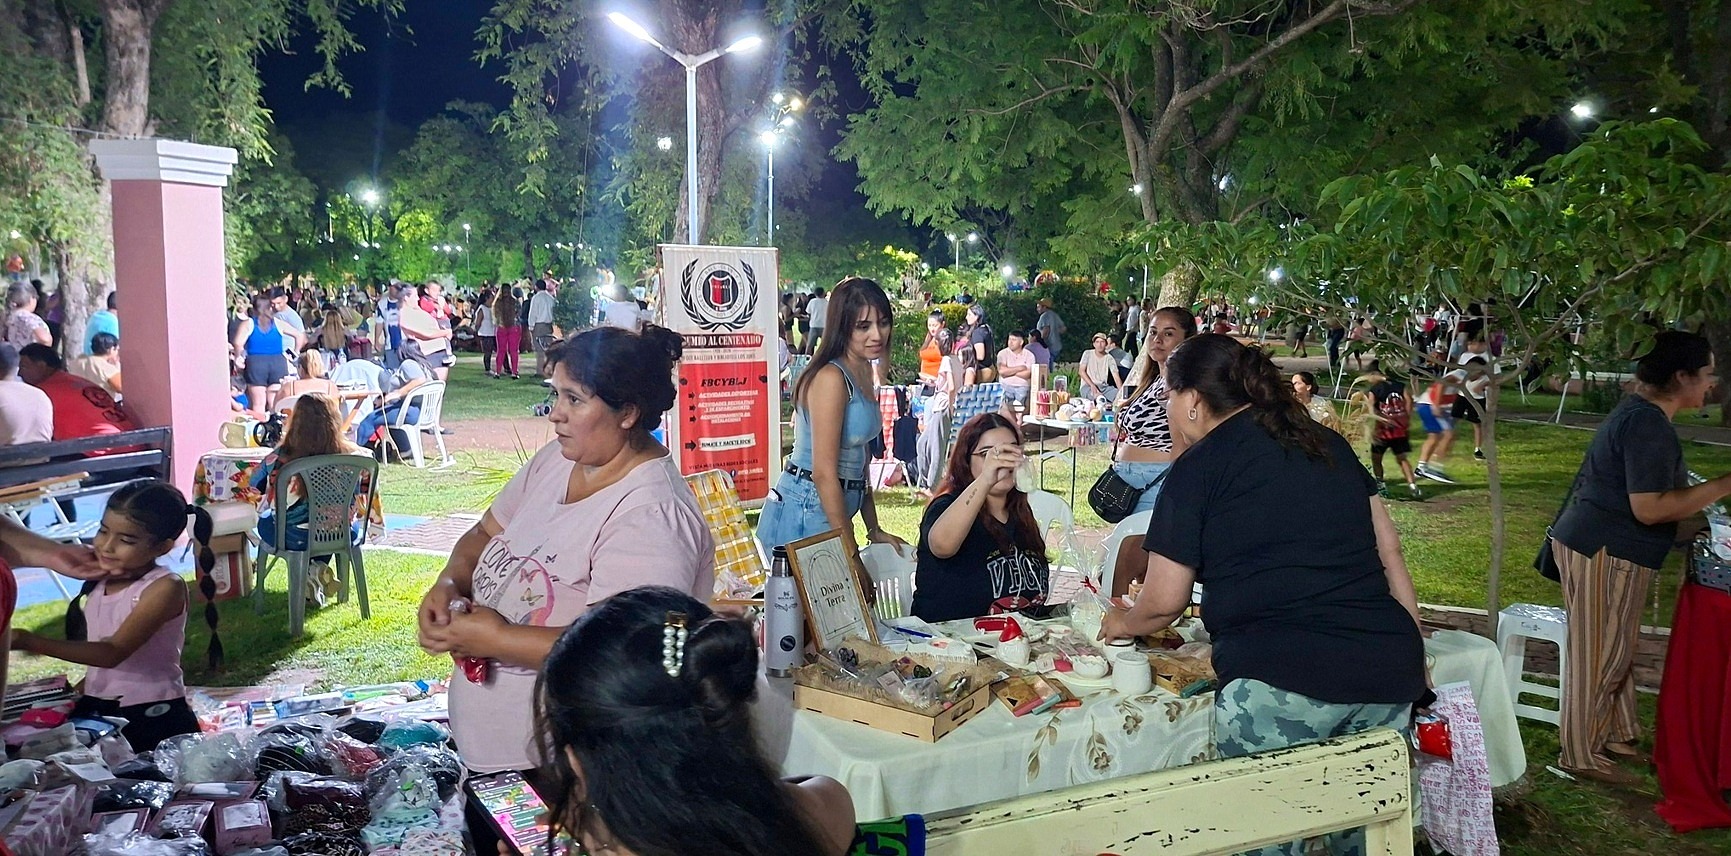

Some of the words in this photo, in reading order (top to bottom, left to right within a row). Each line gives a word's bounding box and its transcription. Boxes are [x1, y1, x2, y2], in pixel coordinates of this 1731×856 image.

[708, 335, 718, 346] AL
[718, 334, 762, 346] CENTENARIO
[701, 377, 747, 387] FBCYBLJ
[483, 541, 516, 578] LOVE
[474, 566, 497, 600] PARIS
[820, 581, 845, 597] Divina
[825, 594, 846, 608] Terra
